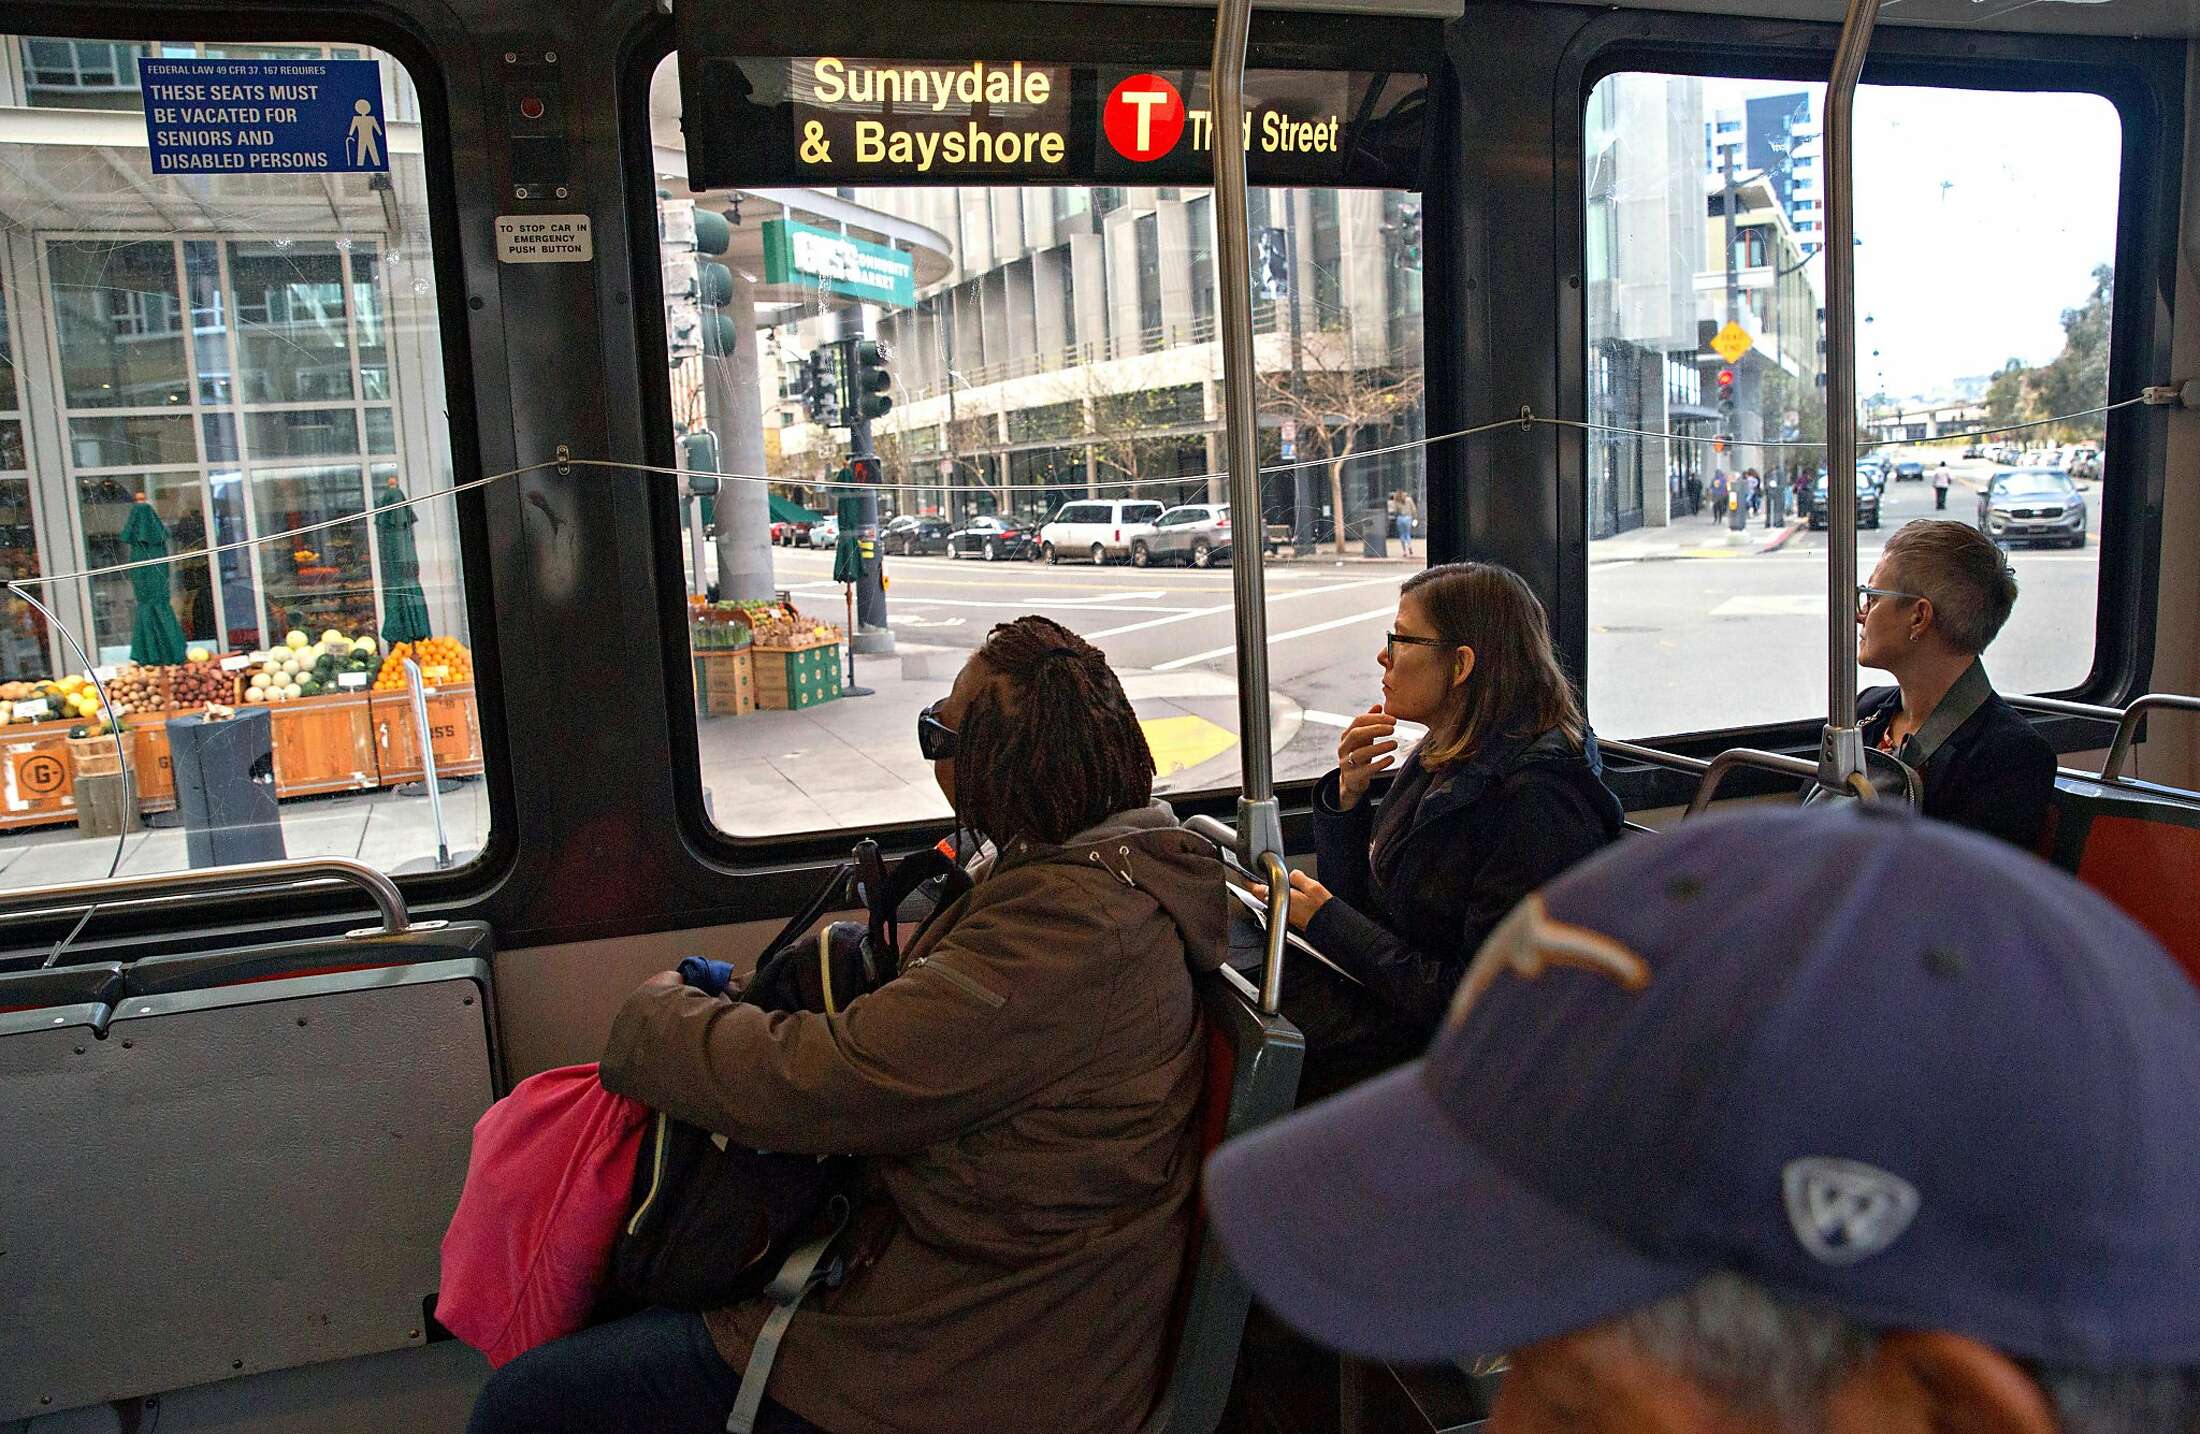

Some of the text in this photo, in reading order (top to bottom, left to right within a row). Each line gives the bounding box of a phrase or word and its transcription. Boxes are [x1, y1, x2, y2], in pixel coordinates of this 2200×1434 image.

[147, 65, 189, 75] FEDERAL
[191, 65, 214, 75] LAW
[216, 66, 227, 75] 49
[228, 66, 247, 75] CFR
[263, 66, 278, 75] 167
[279, 66, 327, 75] REQUIRES
[813, 57, 1051, 112] Sunnydale
[150, 85, 318, 101] THESE SEATS MUST
[154, 107, 297, 124] BE VACATED FOR
[1121, 91, 1339, 153] T Thd Street
[157, 130, 274, 146] SENIORS AND
[799, 119, 1066, 172] & Bayshore
[160, 152, 328, 169] DISABLED PERSONS
[500, 223, 587, 233] TO STOP CAR IN
[513, 234, 575, 243] EMERGENCY
[508, 245, 582, 254] PUSH BUTTON
[35, 764, 51, 784] G
